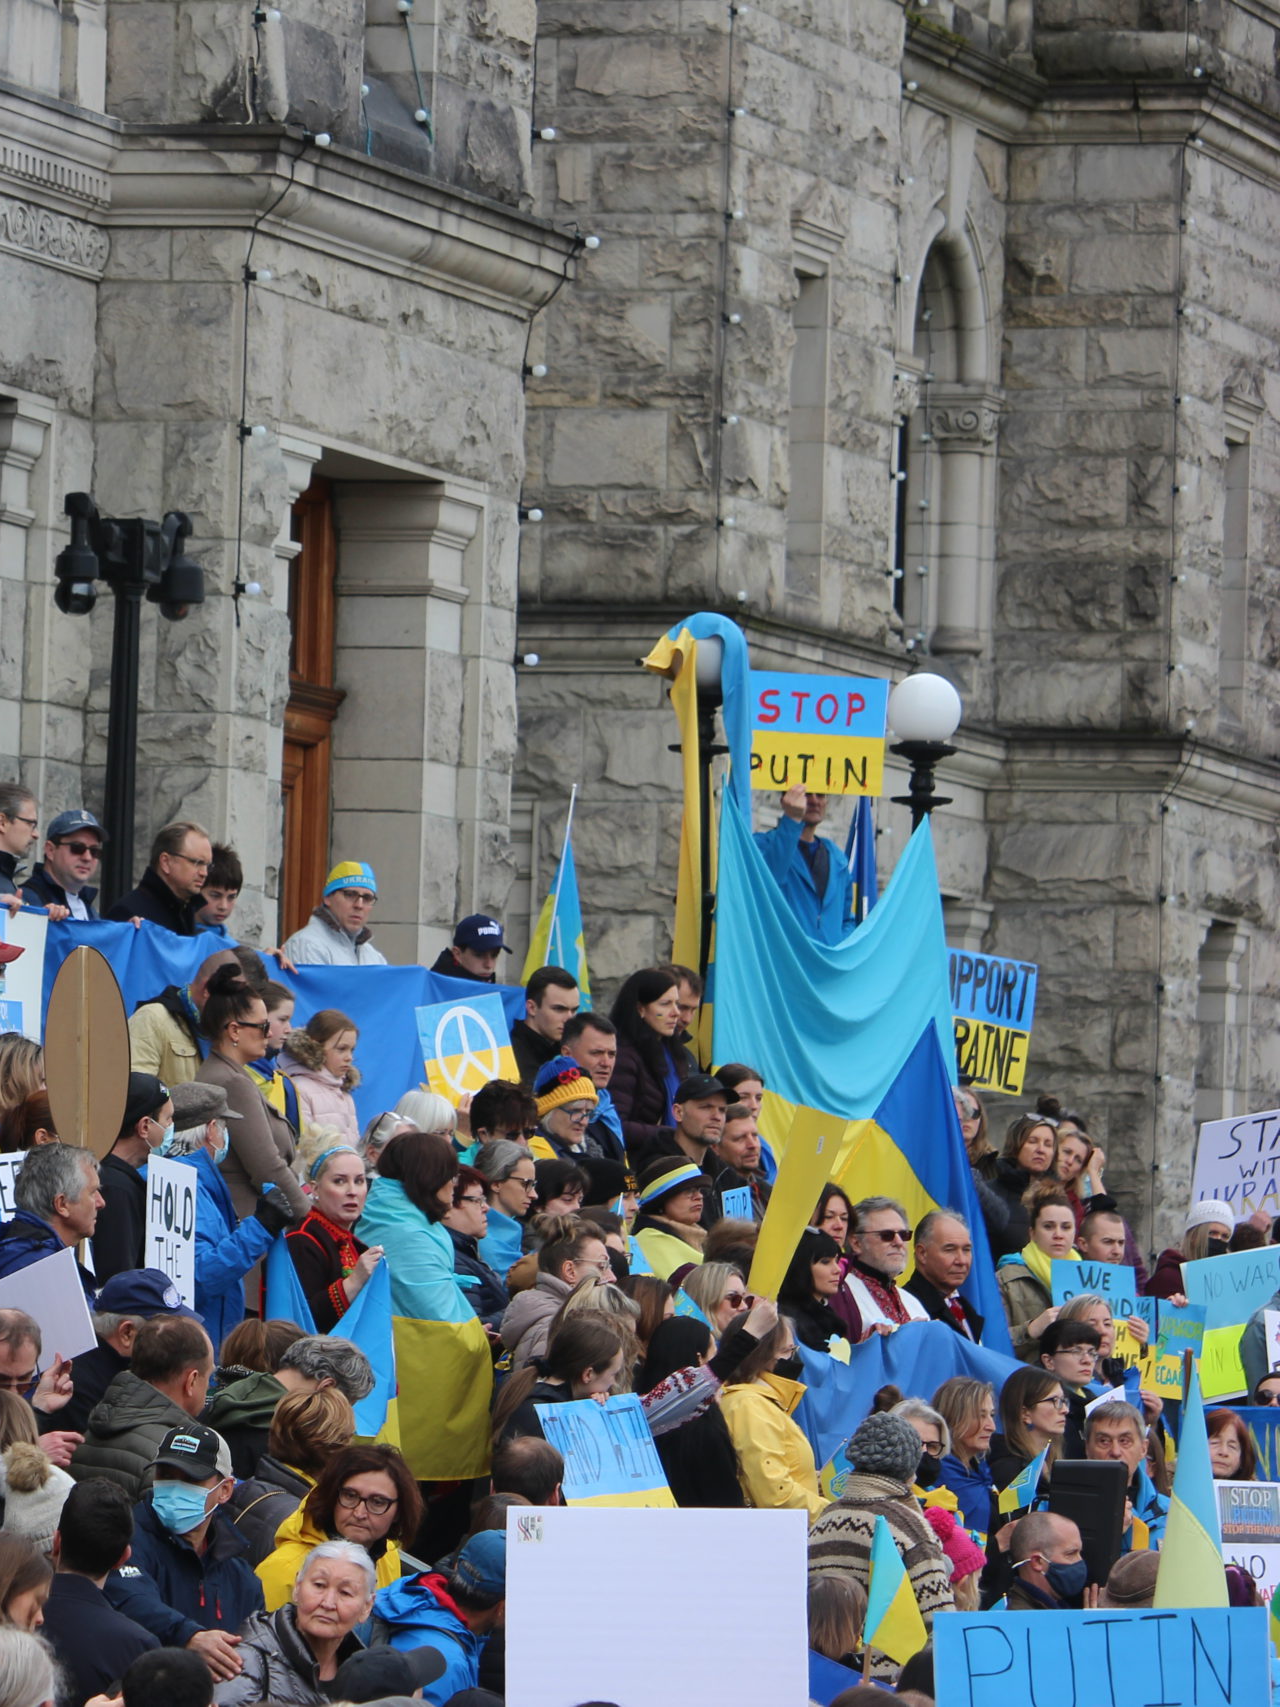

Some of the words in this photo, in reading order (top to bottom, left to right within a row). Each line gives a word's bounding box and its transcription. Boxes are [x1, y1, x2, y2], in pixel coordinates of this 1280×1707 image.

[758, 689, 866, 726] STOP
[949, 953, 1036, 1023] PPORT
[954, 1018, 1027, 1092] RAINE
[151, 1173, 193, 1241] HOLD
[155, 1236, 181, 1279] THE
[1077, 1264, 1111, 1291] WE
[1204, 1271, 1224, 1301] NO
[1230, 1261, 1278, 1293] WAR
[1231, 1487, 1272, 1507] STOP
[1231, 1508, 1274, 1523] PUTIN
[1223, 1523, 1244, 1535] STOP
[1245, 1523, 1263, 1535] THE
[962, 1613, 1232, 1707] PUTIN
